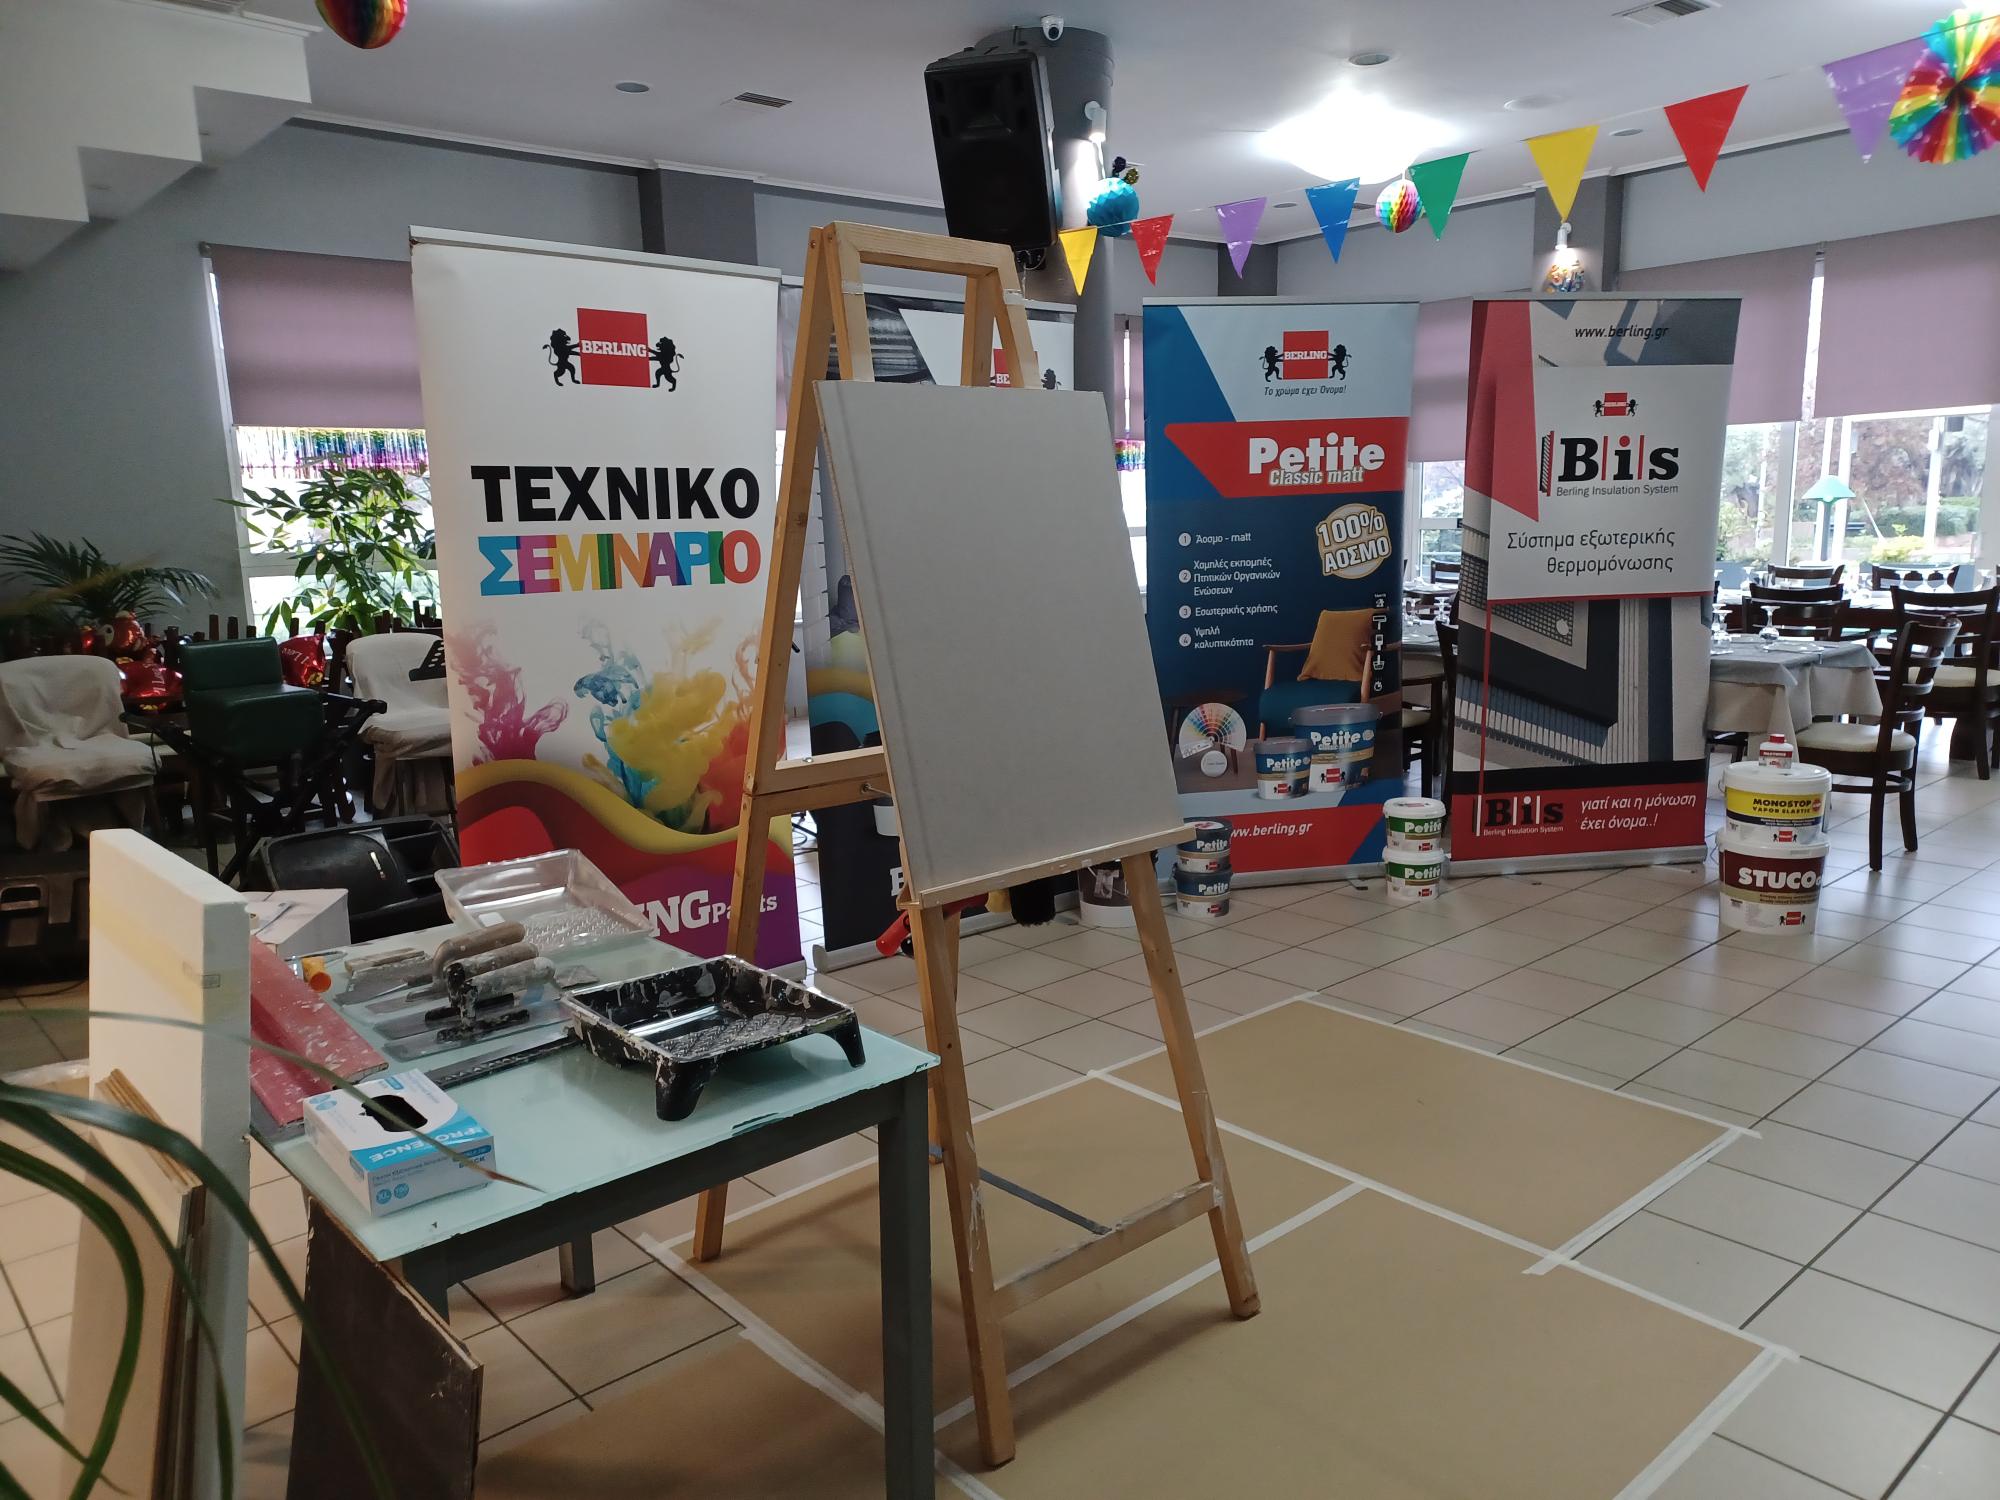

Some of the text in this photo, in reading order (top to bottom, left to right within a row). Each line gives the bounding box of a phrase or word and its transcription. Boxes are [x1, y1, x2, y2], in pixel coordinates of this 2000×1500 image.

[1575, 325, 1668, 340] www.berling.gr
[581, 340, 647, 357] BERLING
[1284, 351, 1327, 360] BERLING
[1249, 432, 1385, 474] Petite
[1269, 466, 1364, 486] Classic matt
[471, 465, 760, 522] ΤΕΧΝΙΚΟ
[1557, 484, 1679, 498] Berling Insulation System
[1319, 509, 1384, 546] 100%
[1507, 528, 1675, 551] Σύστημα εξωτερικής
[478, 529, 761, 596] ΣΕΜΙΝΑΡΙΟ
[1325, 537, 1389, 573] ΑΟΣΜΟ
[1547, 555, 1674, 576] θερμομόνωσης
[1311, 730, 1361, 746] Petite
[1266, 757, 1302, 768] Petite
[1581, 793, 1696, 813] γιατί και η μόνωση
[1753, 798, 1812, 808] MONOSTOP
[1508, 826, 1539, 835] Insulation
[1580, 817, 1605, 830] έχει
